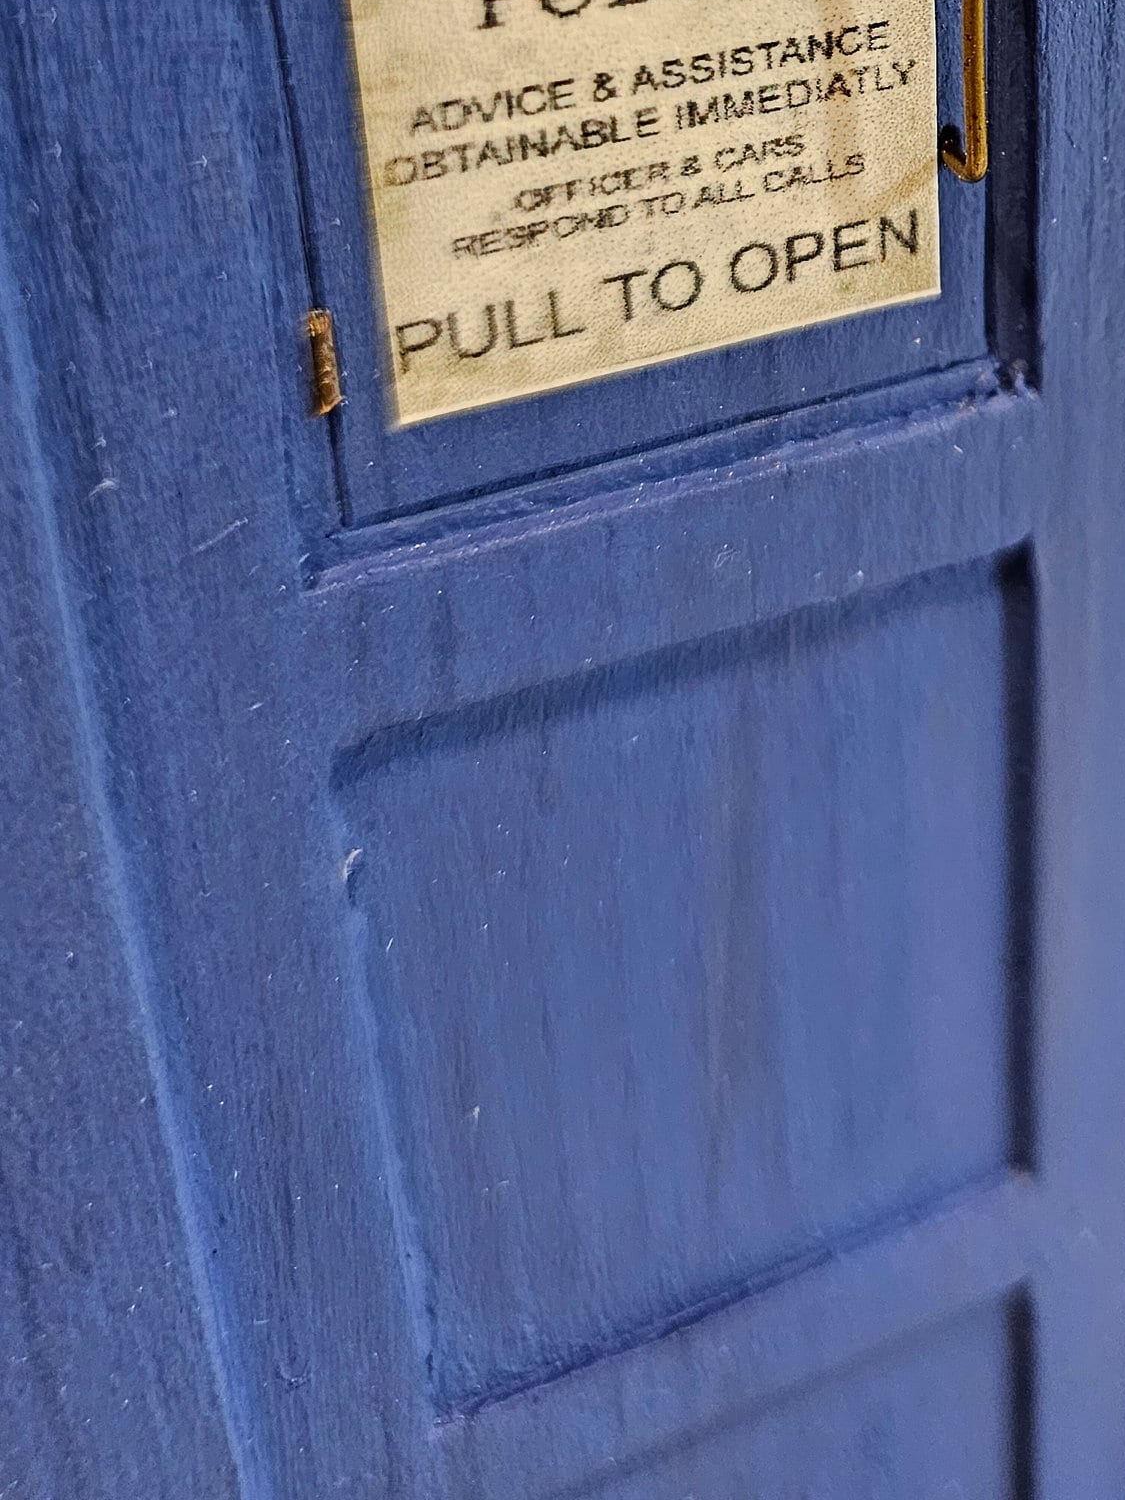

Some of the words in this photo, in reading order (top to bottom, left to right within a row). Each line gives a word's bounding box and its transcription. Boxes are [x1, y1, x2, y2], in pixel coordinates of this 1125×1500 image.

[383, 107, 660, 186] OBTAINABLE
[675, 60, 915, 131] IMMEDIATLY
[409, 77, 577, 136] ADVICE
[593, 73, 616, 104] &
[632, 21, 891, 96] ASSISTANCE
[452, 203, 631, 258] RESPOND
[644, 191, 684, 218] TO
[692, 177, 755, 208] ALL
[763, 154, 866, 193] CALLS
[680, 154, 702, 177] &
[713, 135, 806, 171] CARS
[396, 290, 585, 374] PULL
[603, 259, 702, 321] TO
[729, 208, 920, 292] OPEN
